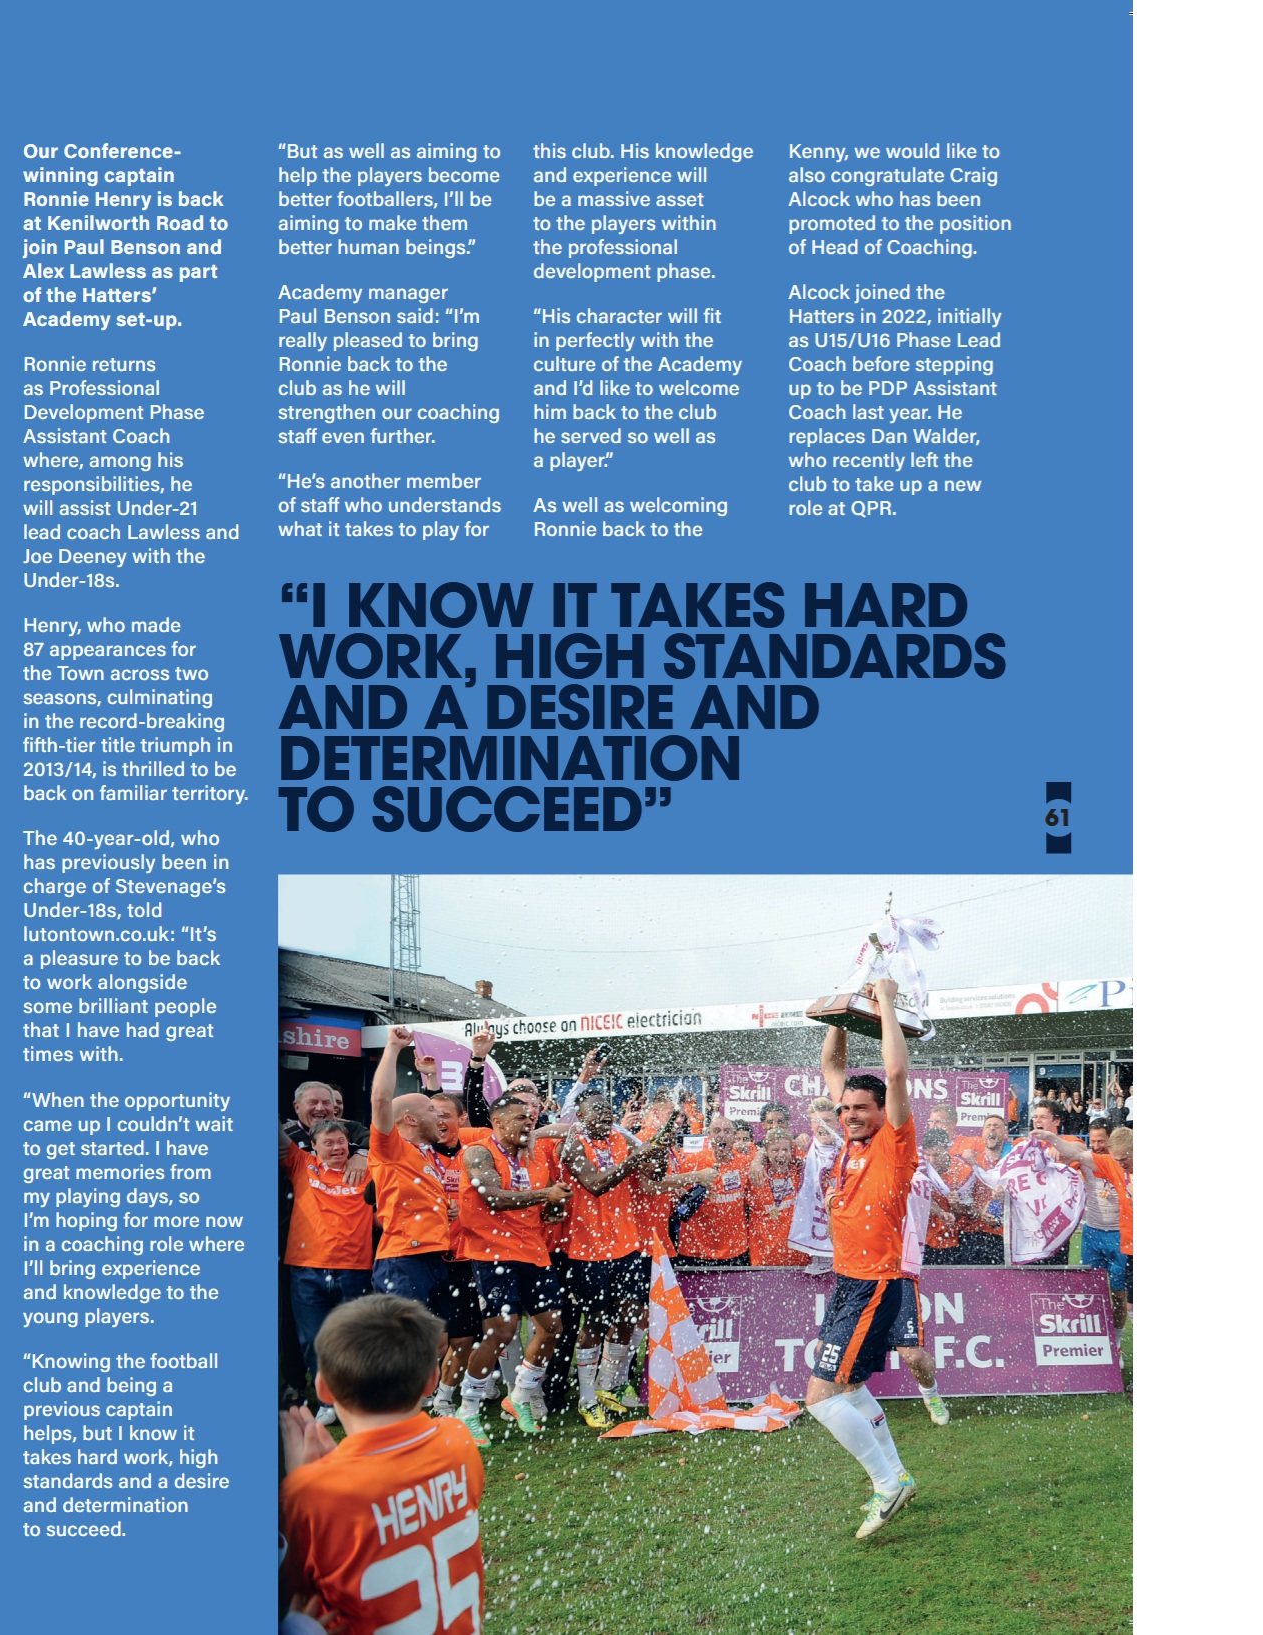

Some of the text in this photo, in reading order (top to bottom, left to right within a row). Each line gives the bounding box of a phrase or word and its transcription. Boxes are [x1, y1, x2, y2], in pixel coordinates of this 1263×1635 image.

[24, 143, 181, 158] Our Conference-
[279, 143, 501, 162] “But as well as aiming to
[533, 143, 753, 162] this club. His knowledge
[790, 143, 1000, 162] Kenny, we would like to
[23, 167, 174, 186] winning captain
[24, 191, 224, 210] Ronnie Henry is back
[278, 284, 448, 303] Academy manager
[789, 284, 945, 303] Alcock joined the
[280, 308, 479, 323] Paul Benson said: “I’m
[534, 308, 721, 324] “His character will fit
[25, 356, 156, 372] Ronnie returns
[24, 380, 159, 395] as Professional
[279, 473, 481, 488] “He’s another member
[533, 497, 727, 516] As well as welcoming
[282, 582, 967, 628] “I KNOW IT TAKES HARD
[25, 617, 181, 636] Henry, who made
[24, 641, 196, 660] 87 appearances for
[279, 633, 1006, 687] WORK, HIGH STANDARDS
[278, 684, 819, 730] AND A DESIRE AND
[281, 735, 739, 781] DETERMINATION
[278, 786, 671, 832] TO SUCCEED”
[1045, 809, 1069, 826] 61
[23, 830, 219, 849] The 40-year-old, who
[24, 854, 229, 873] has previously been in
[512, 1018, 557, 1035] choose
[560, 1018, 577, 1033] an
[626, 1008, 703, 1029] electrician
[278, 1026, 350, 1050] shire
[728, 1085, 772, 1101] Skrill
[962, 1080, 979, 1090] The
[24, 1092, 230, 1111] “When the opportunity
[960, 1091, 1001, 1107] Skrill
[729, 1106, 760, 1117] Premi
[1039, 1297, 1065, 1311] The
[1039, 1313, 1102, 1335] Skrill
[821, 1343, 842, 1365] 25
[934, 1335, 1005, 1369] F.C.
[1042, 1343, 1104, 1358] Premier
[24, 1353, 218, 1372] “Knowing the football
[371, 1464, 468, 1546] HENRY
[23, 1521, 125, 1536] to succeed.
